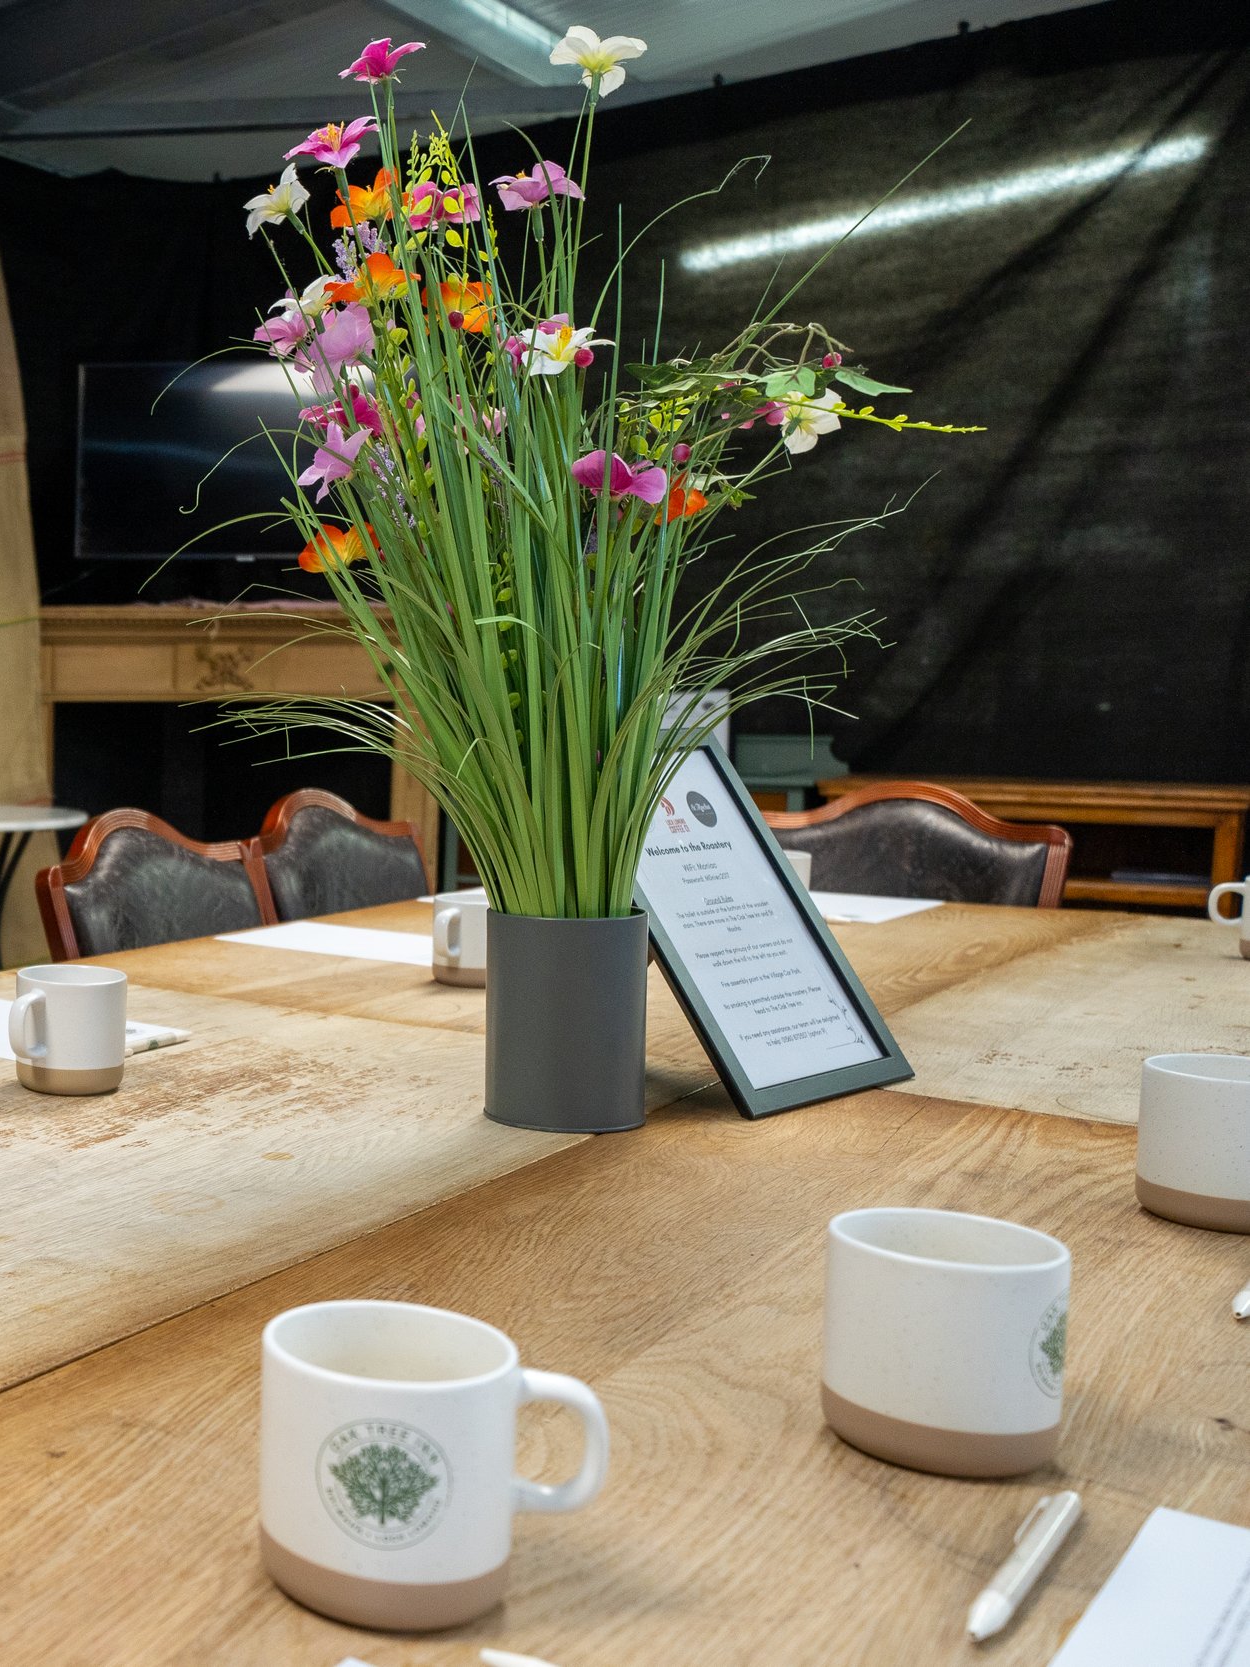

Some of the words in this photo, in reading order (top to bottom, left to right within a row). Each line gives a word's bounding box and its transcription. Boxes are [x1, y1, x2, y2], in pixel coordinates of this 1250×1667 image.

[645, 844, 680, 857] Welcome
[681, 844, 689, 853] to
[689, 842, 702, 852] the
[700, 841, 732, 850] Roastery
[704, 896, 721, 905] Ground
[720, 895, 734, 903] Rules
[366, 1424, 409, 1441] TREE
